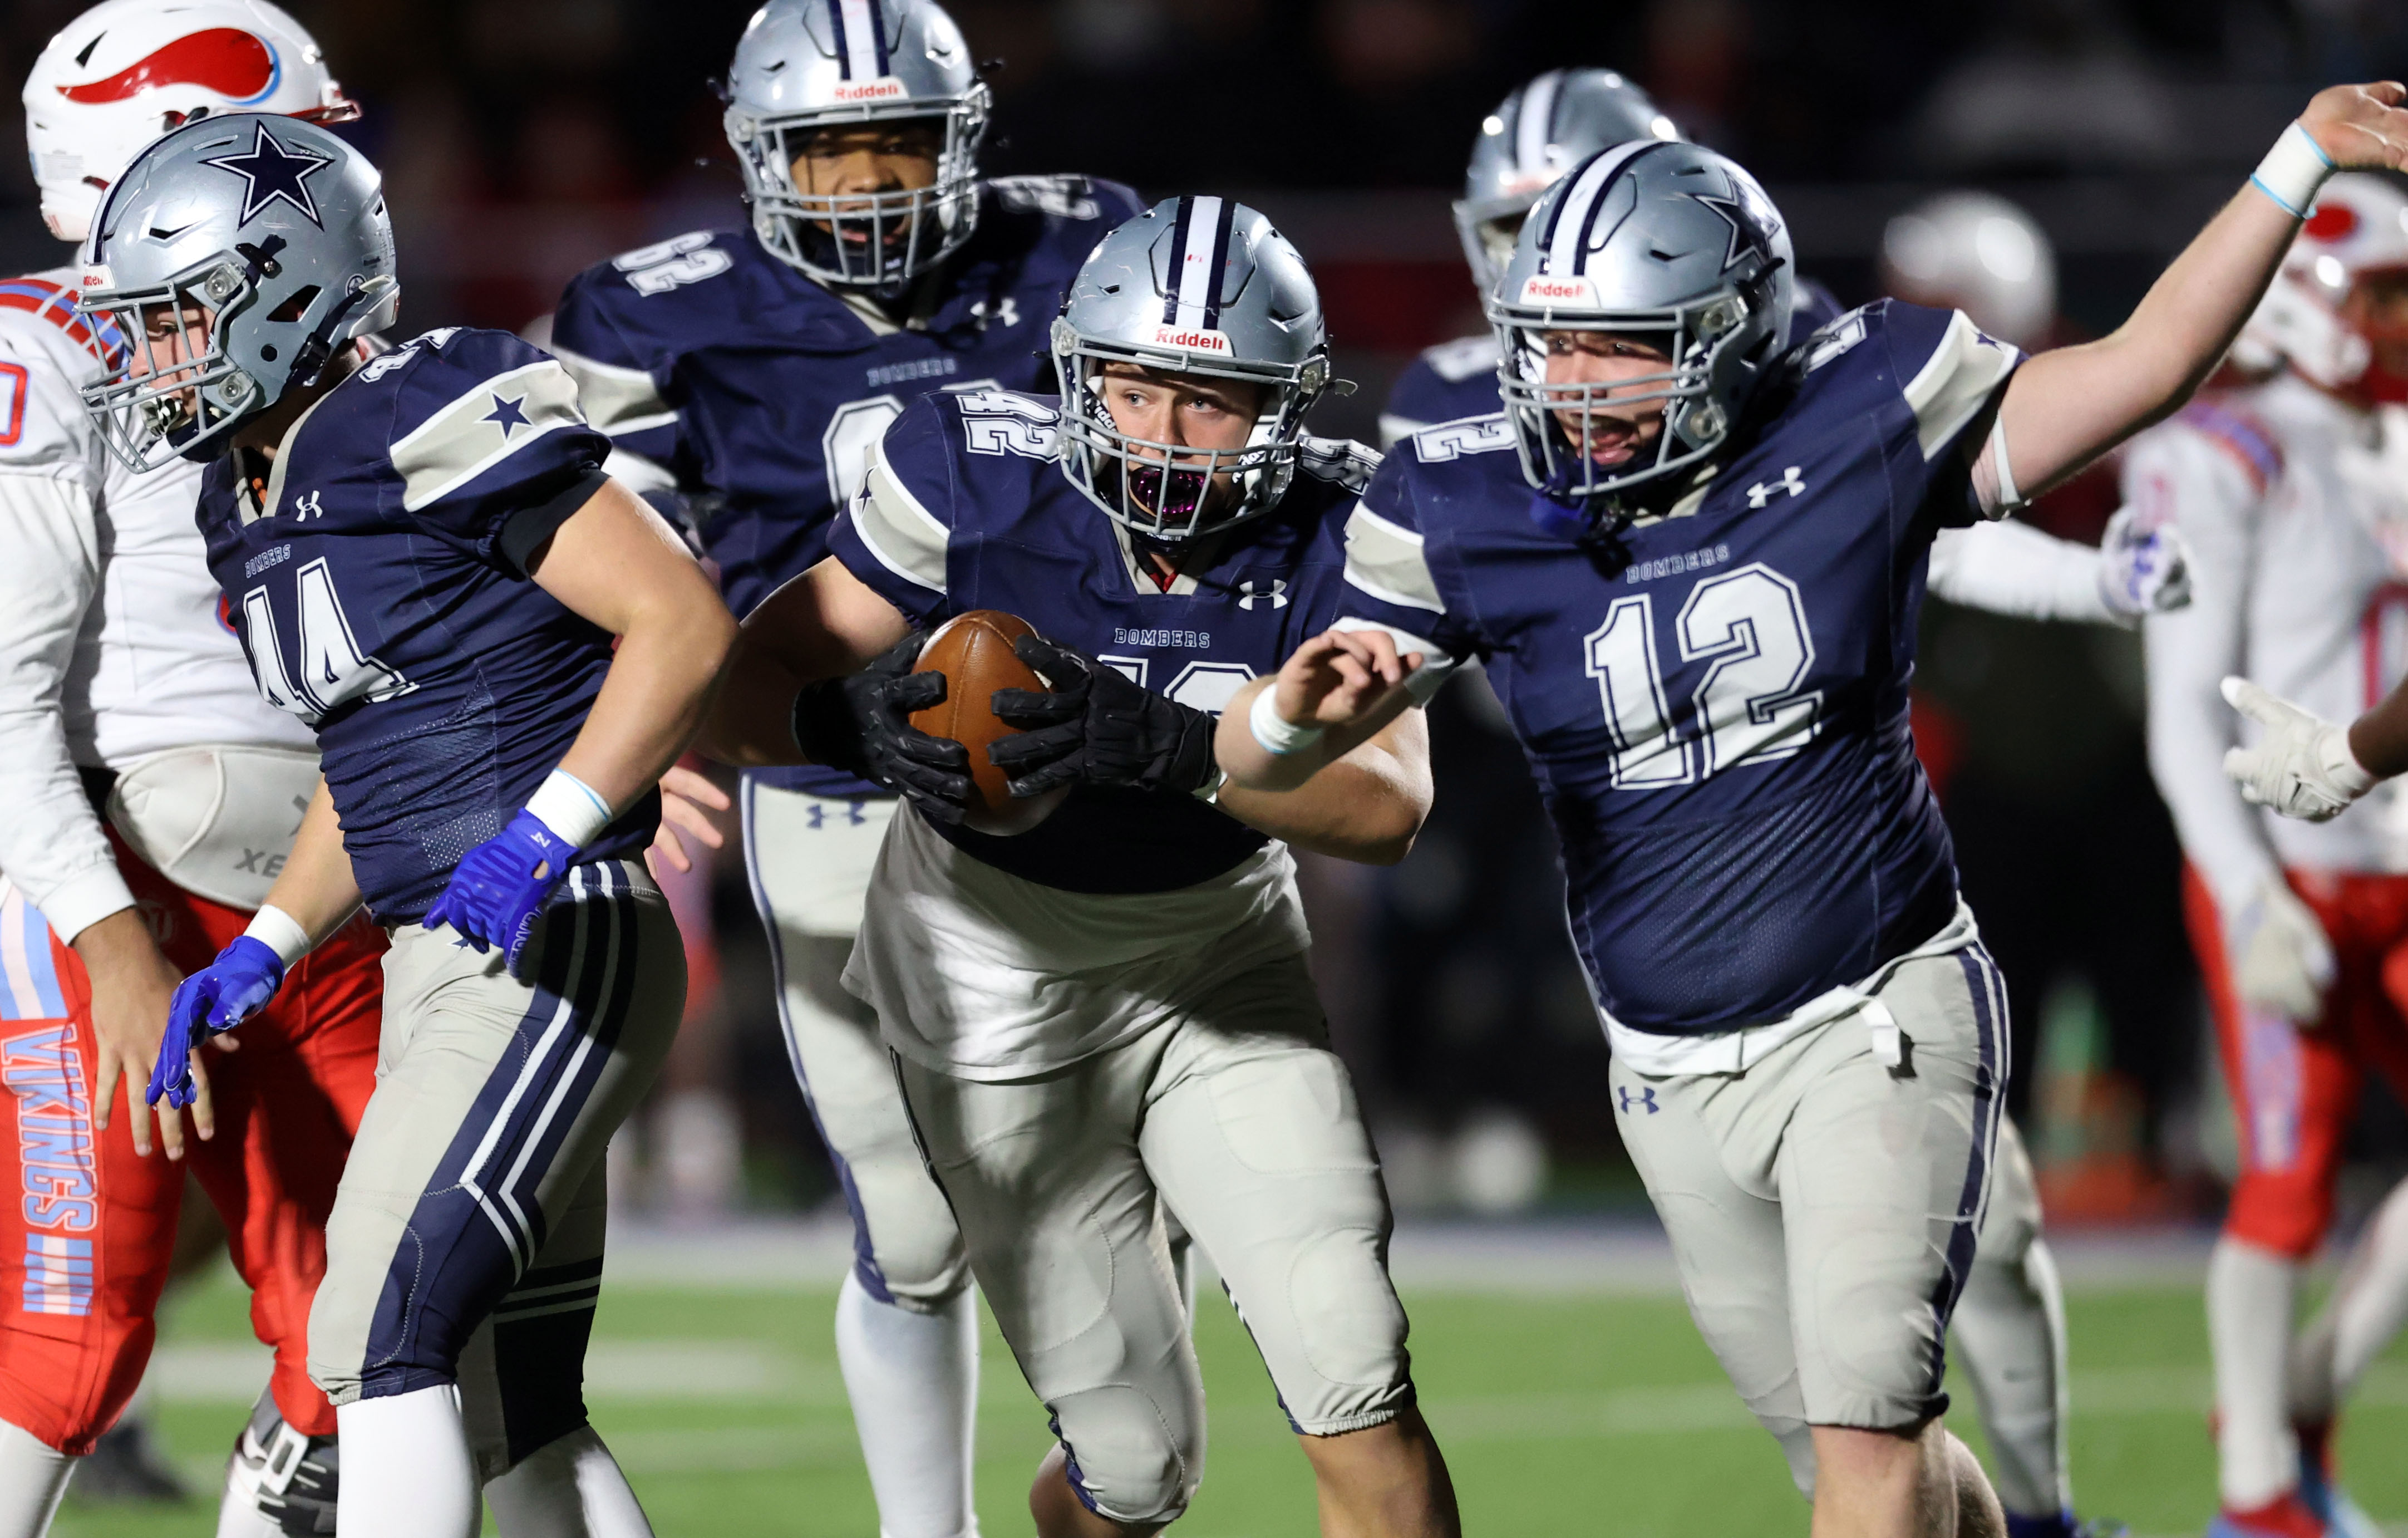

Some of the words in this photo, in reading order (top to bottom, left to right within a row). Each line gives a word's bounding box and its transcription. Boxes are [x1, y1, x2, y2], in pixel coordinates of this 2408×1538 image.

[1156, 328, 1223, 350] Riddell
[245, 544, 291, 578] BOMBERS
[1625, 544, 1730, 584] BOMBERS
[1114, 628, 1210, 648] BOMBERS
[1583, 562, 1823, 790] 12
[1, 1023, 99, 1232] VIKINGS
